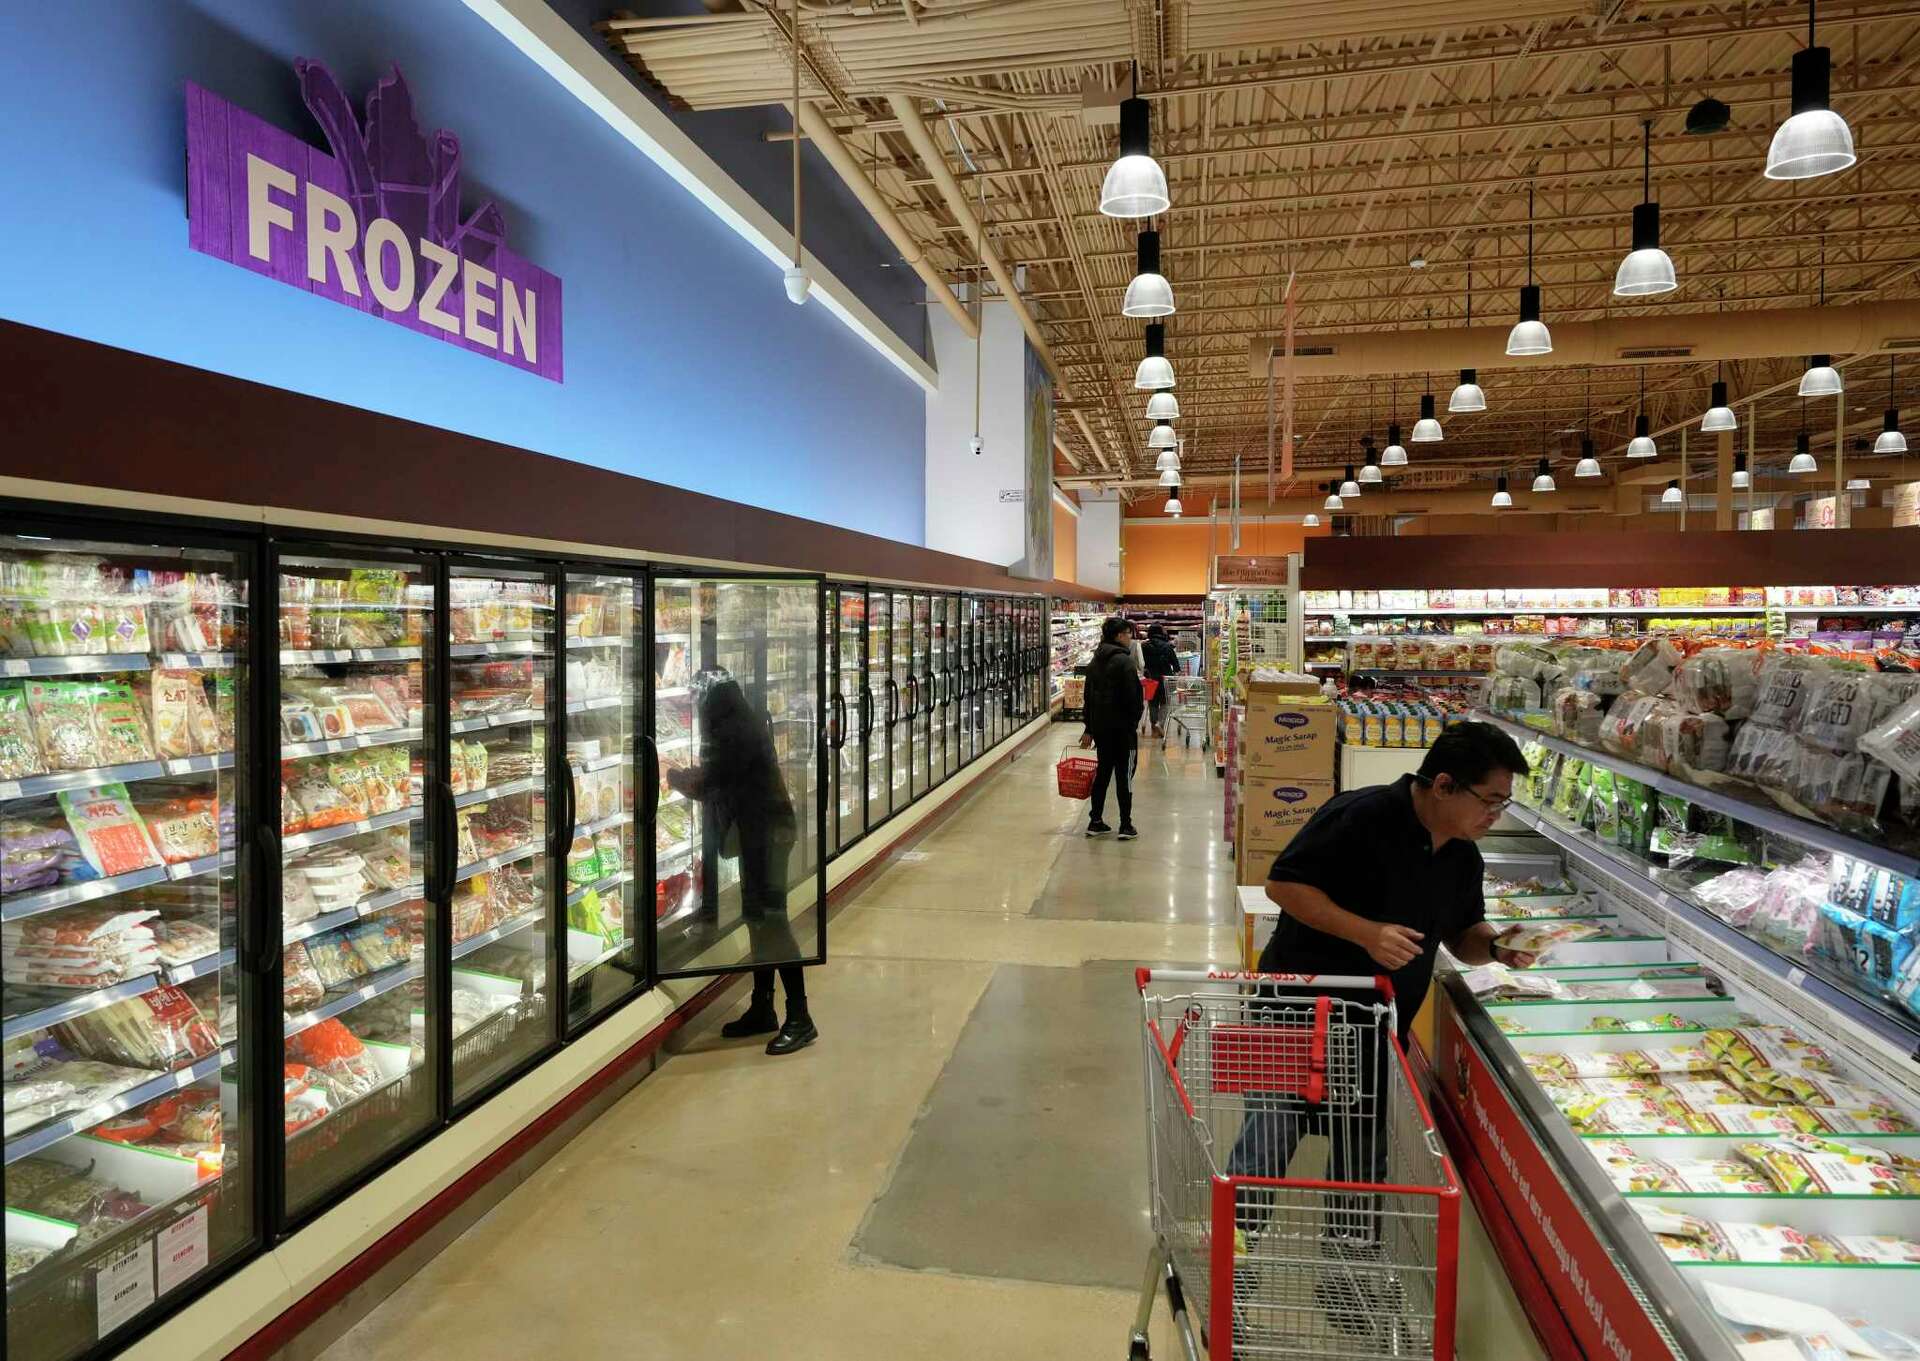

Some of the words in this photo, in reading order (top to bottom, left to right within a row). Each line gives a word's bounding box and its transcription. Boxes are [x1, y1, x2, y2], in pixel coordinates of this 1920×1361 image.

[247, 152, 537, 364] FROZEN
[1264, 734, 1290, 745] Magic
[1293, 732, 1318, 741] Sarap
[1263, 808, 1290, 819] Magic
[1584, 1279, 1603, 1329] best
